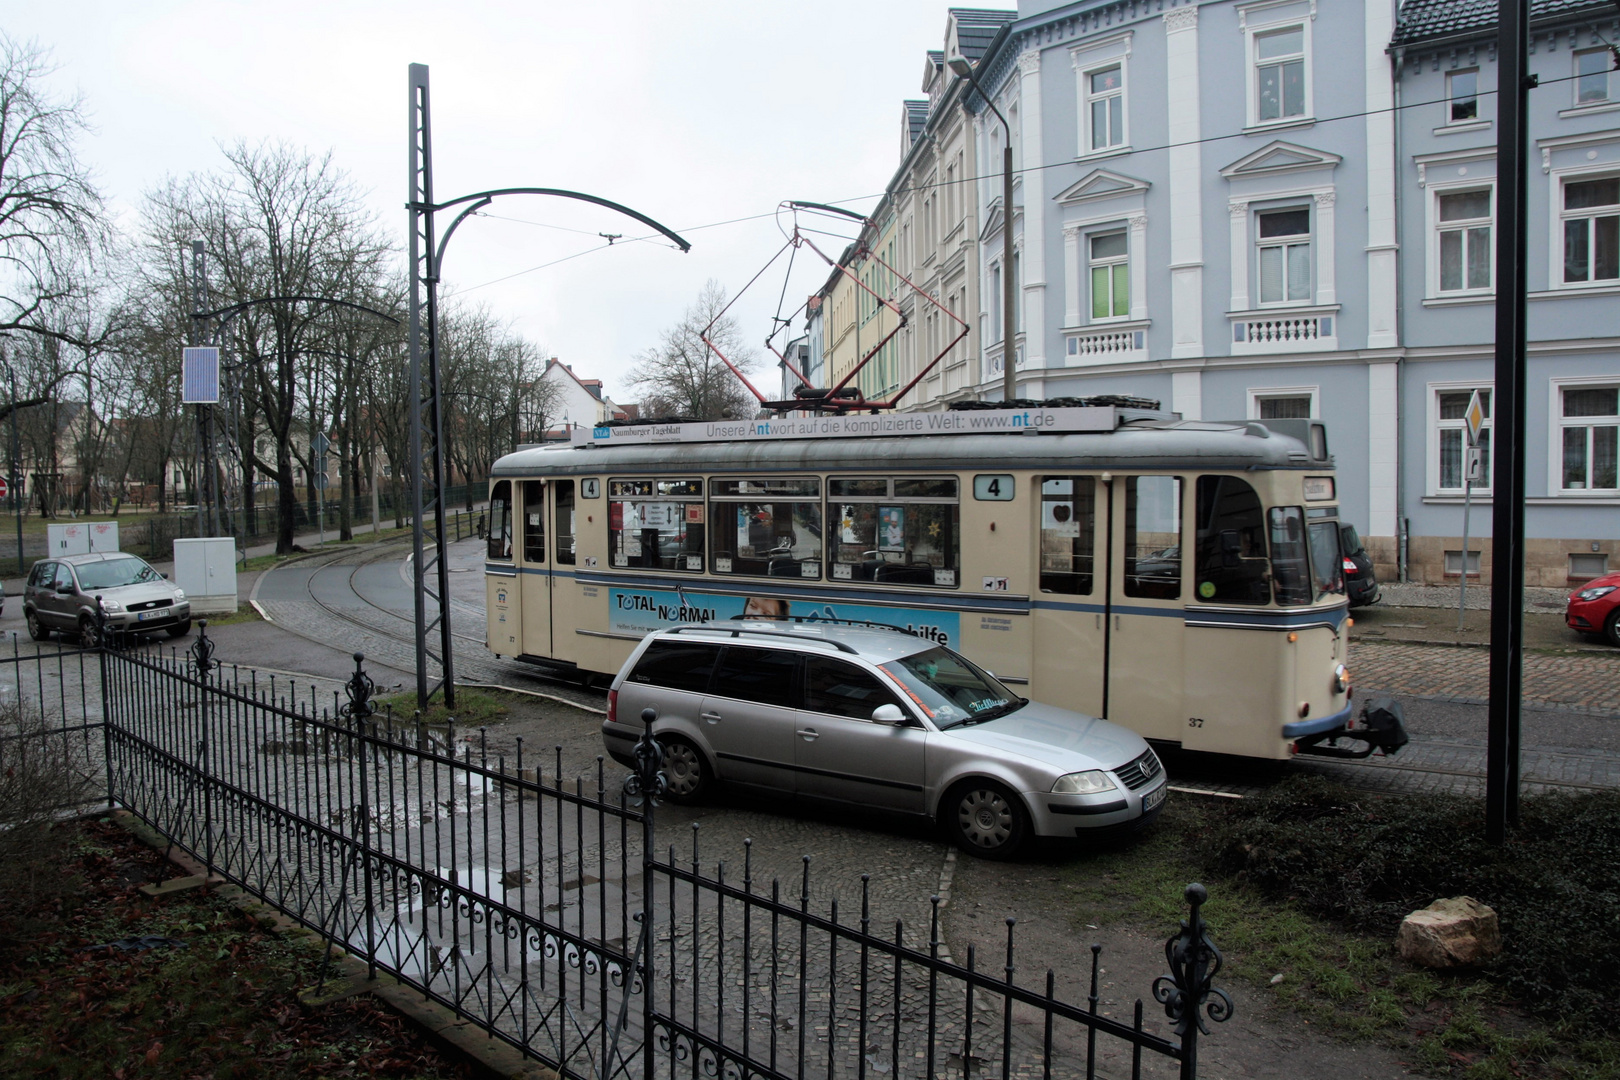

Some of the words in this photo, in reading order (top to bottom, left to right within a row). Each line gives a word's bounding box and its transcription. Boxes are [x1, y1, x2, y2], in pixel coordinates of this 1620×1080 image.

[612, 427, 650, 436] Naumburger
[651, 426, 681, 435] Tageblatt
[707, 424, 745, 437] Unsere
[749, 421, 796, 436] Antwort
[799, 420, 819, 434] auf
[821, 419, 840, 433] die
[844, 416, 923, 435] komplizierte
[927, 414, 965, 430] Welt:
[970, 411, 1055, 428] www.nt.de
[588, 481, 595, 495] 4
[988, 479, 1001, 496] 4
[640, 505, 646, 525] 4
[617, 594, 656, 611] TOTAL
[1189, 718, 1204, 728] 37
